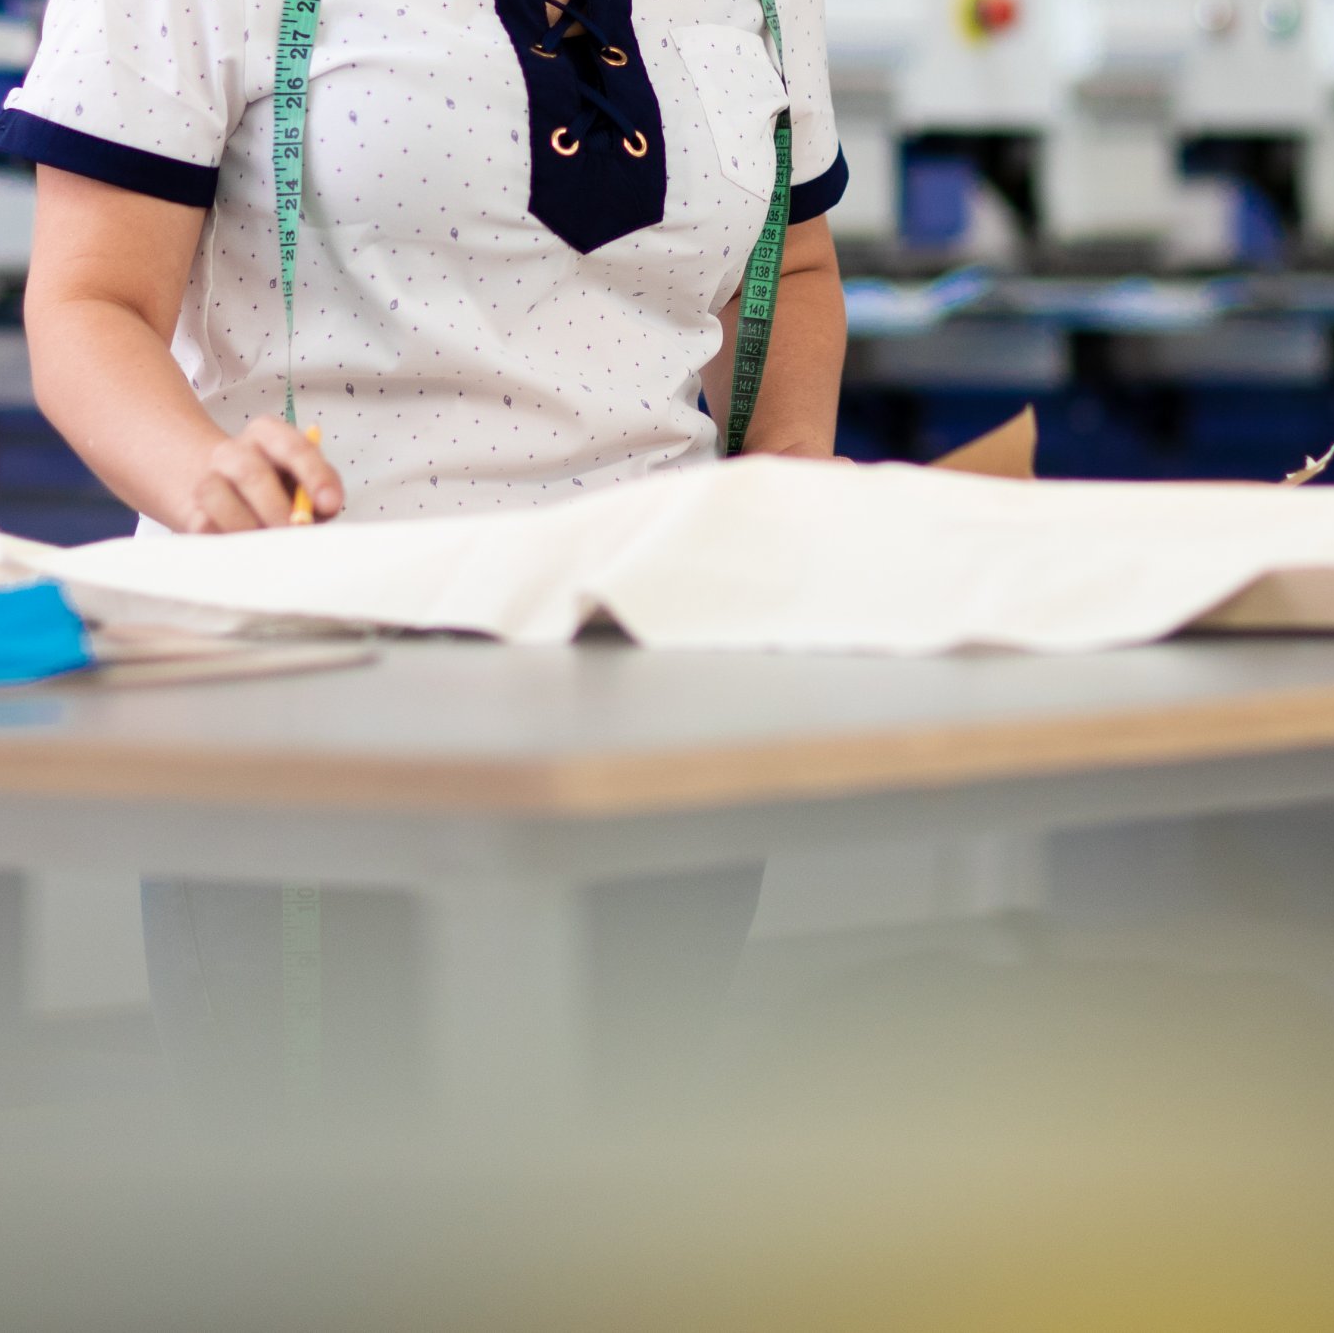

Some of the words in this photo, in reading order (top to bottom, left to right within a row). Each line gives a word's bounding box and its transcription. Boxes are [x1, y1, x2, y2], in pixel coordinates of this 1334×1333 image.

[290, 29, 311, 60] 27
[285, 77, 305, 110] 26
[284, 127, 300, 160] 25
[775, 170, 784, 184] 33
[284, 180, 299, 210] 24
[762, 228, 777, 241] 136
[284, 230, 296, 262] 23
[758, 246, 774, 259] 137
[754, 265, 770, 278] 138
[751, 284, 768, 298] 139
[748, 303, 766, 317] 140
[747, 323, 763, 336] 141
[744, 342, 759, 355] 142
[741, 361, 755, 374] 143
[738, 380, 752, 392] 144
[736, 399, 748, 411] 145
